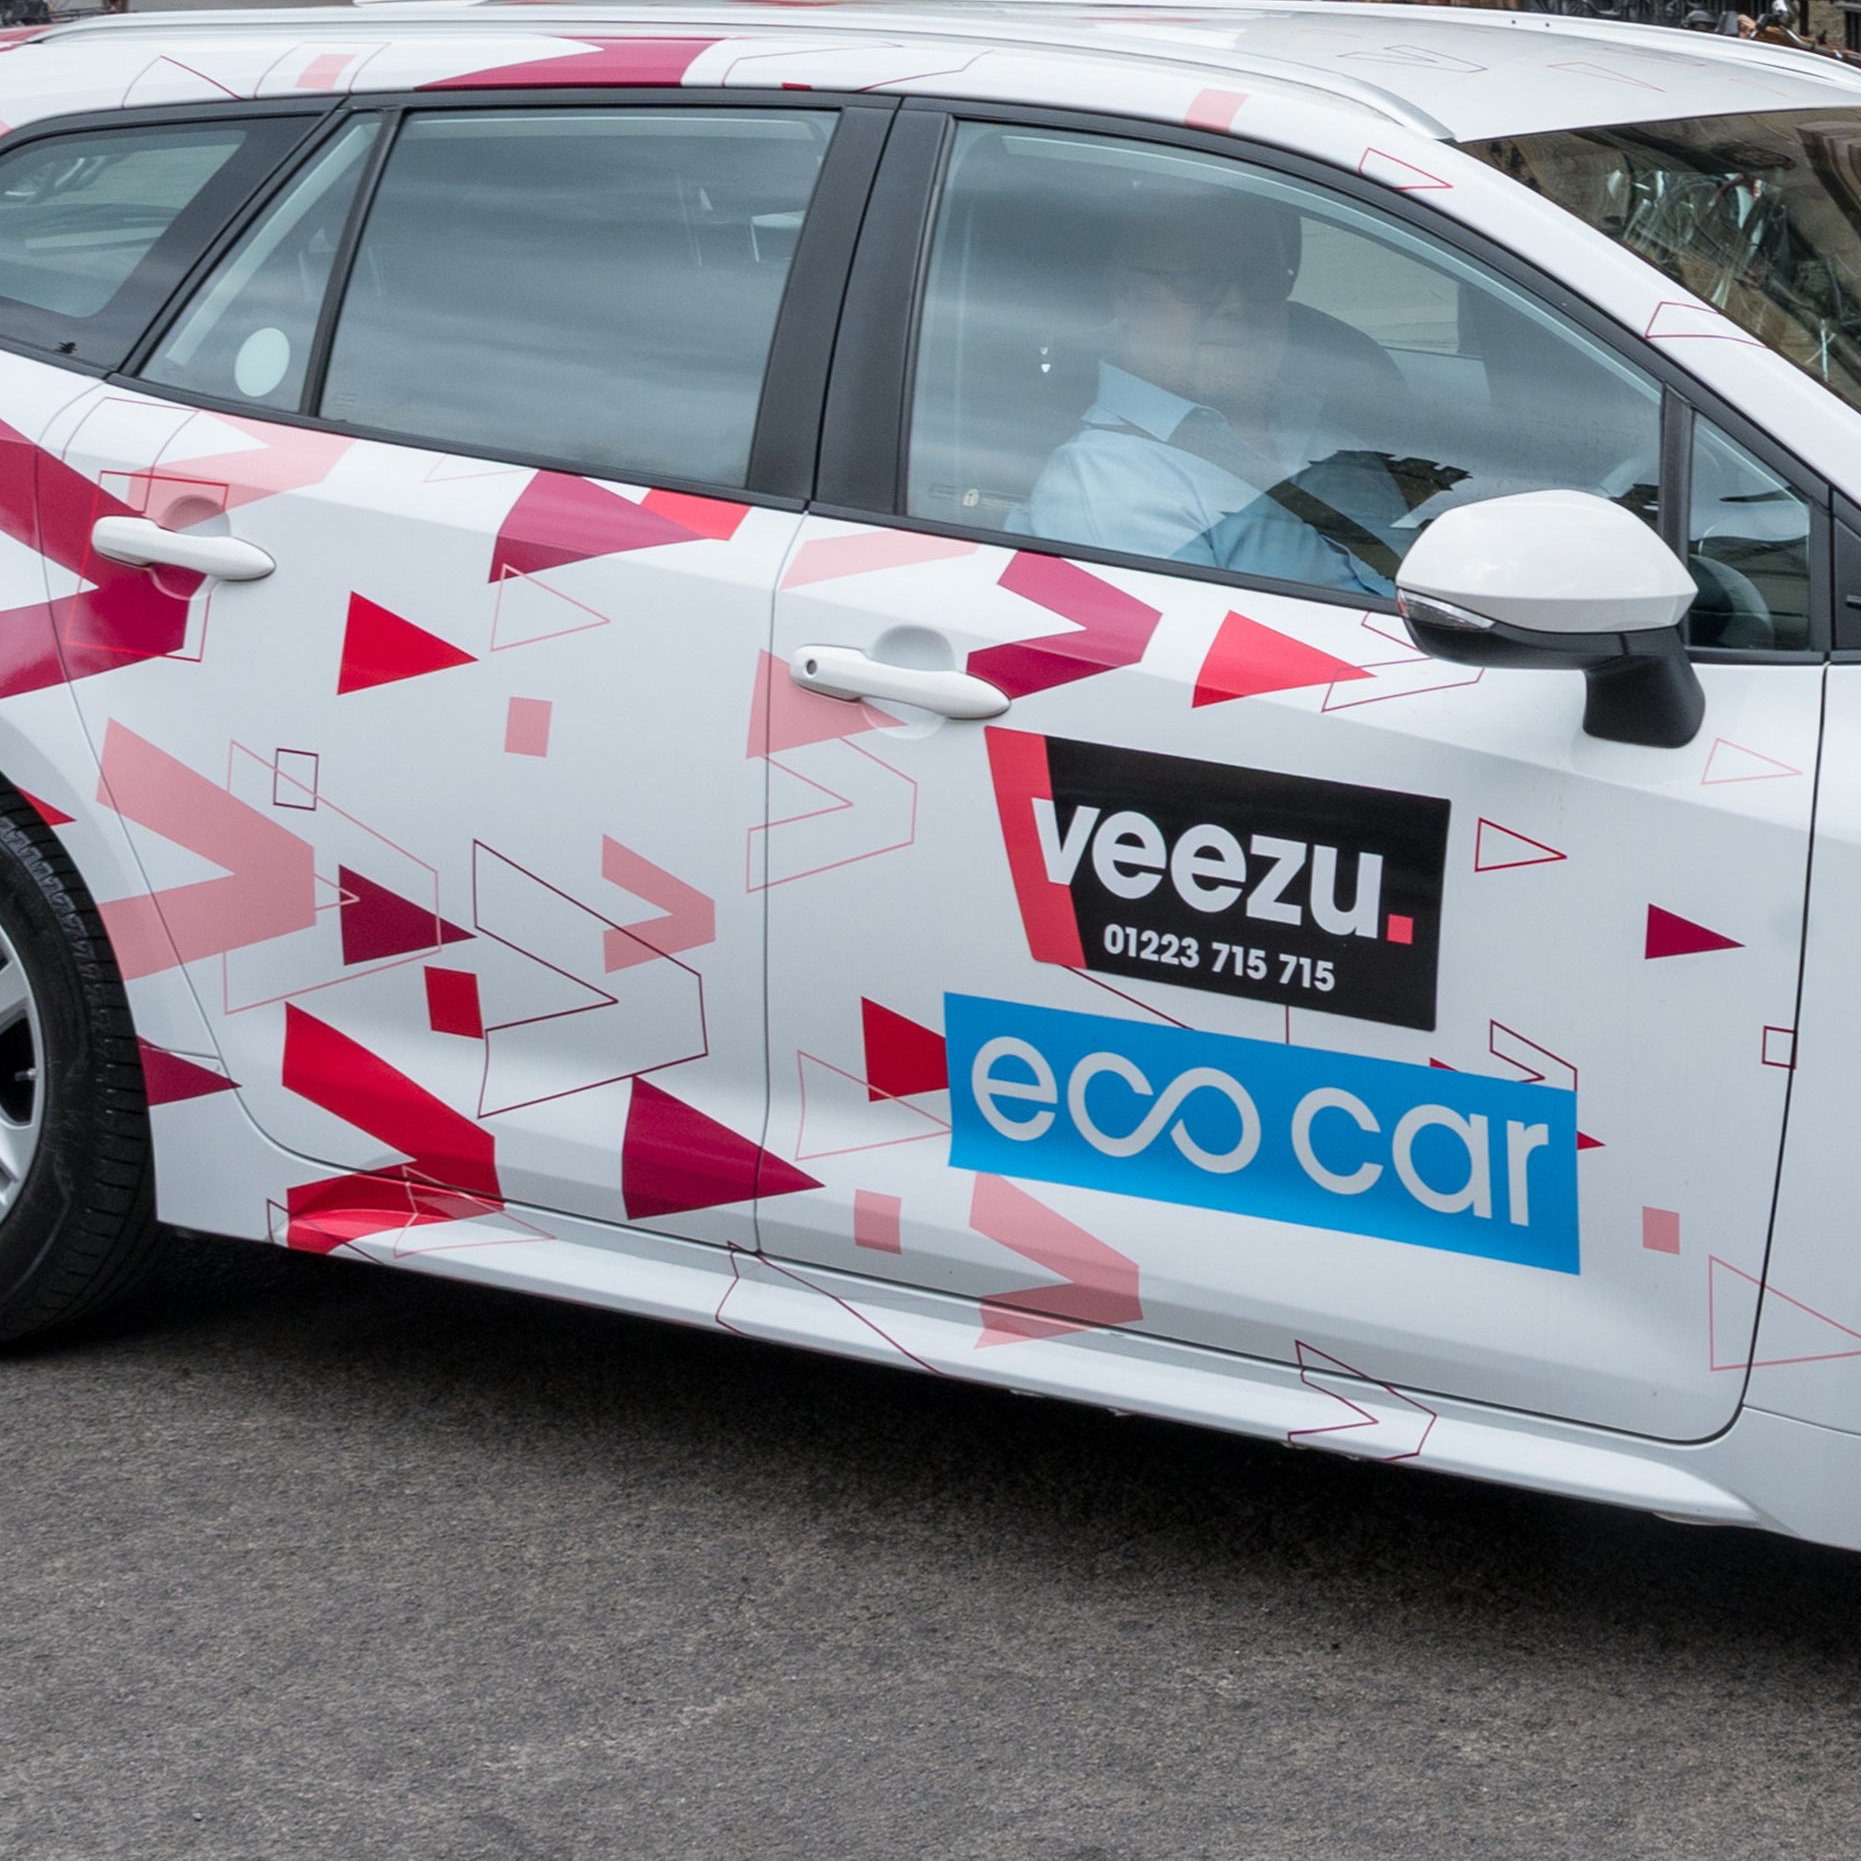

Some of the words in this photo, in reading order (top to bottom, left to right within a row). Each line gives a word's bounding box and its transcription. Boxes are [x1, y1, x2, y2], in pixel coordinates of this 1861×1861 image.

[1104, 923, 1199, 968] 01223
[1211, 941, 1268, 981] 715
[1278, 953, 1335, 992] 715
[971, 1035, 1261, 1175] eco
[1290, 1086, 1549, 1227] car
